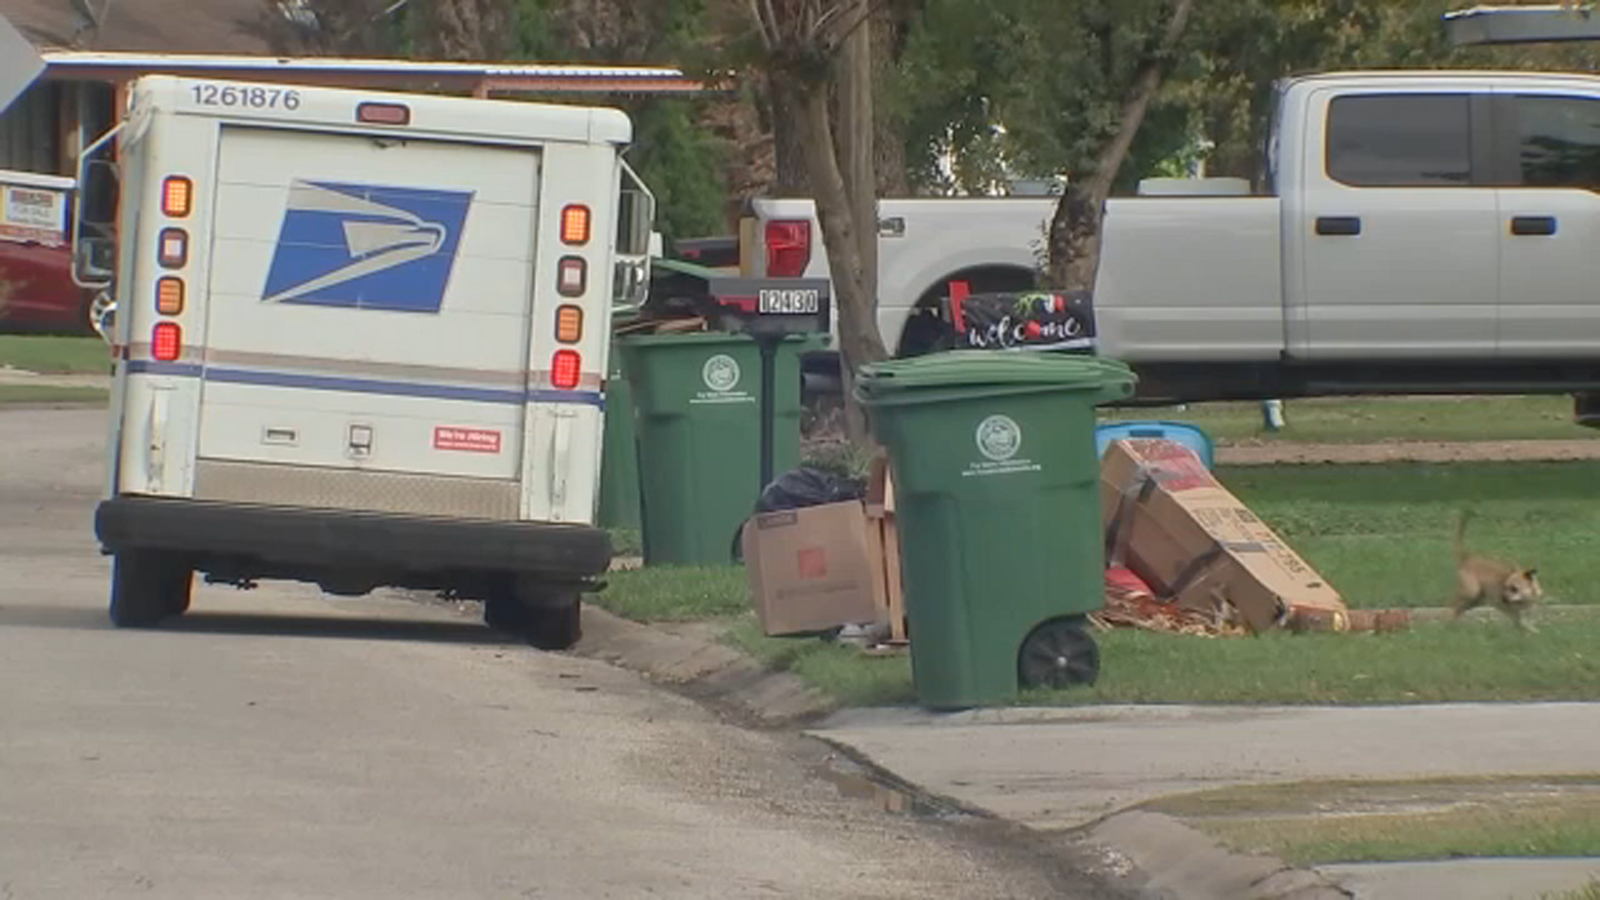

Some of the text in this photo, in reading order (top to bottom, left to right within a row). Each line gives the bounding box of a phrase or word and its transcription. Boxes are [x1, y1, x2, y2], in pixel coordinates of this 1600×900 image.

[191, 84, 300, 111] 1261876
[760, 290, 818, 312] 12430
[968, 315, 1081, 349] welcome
